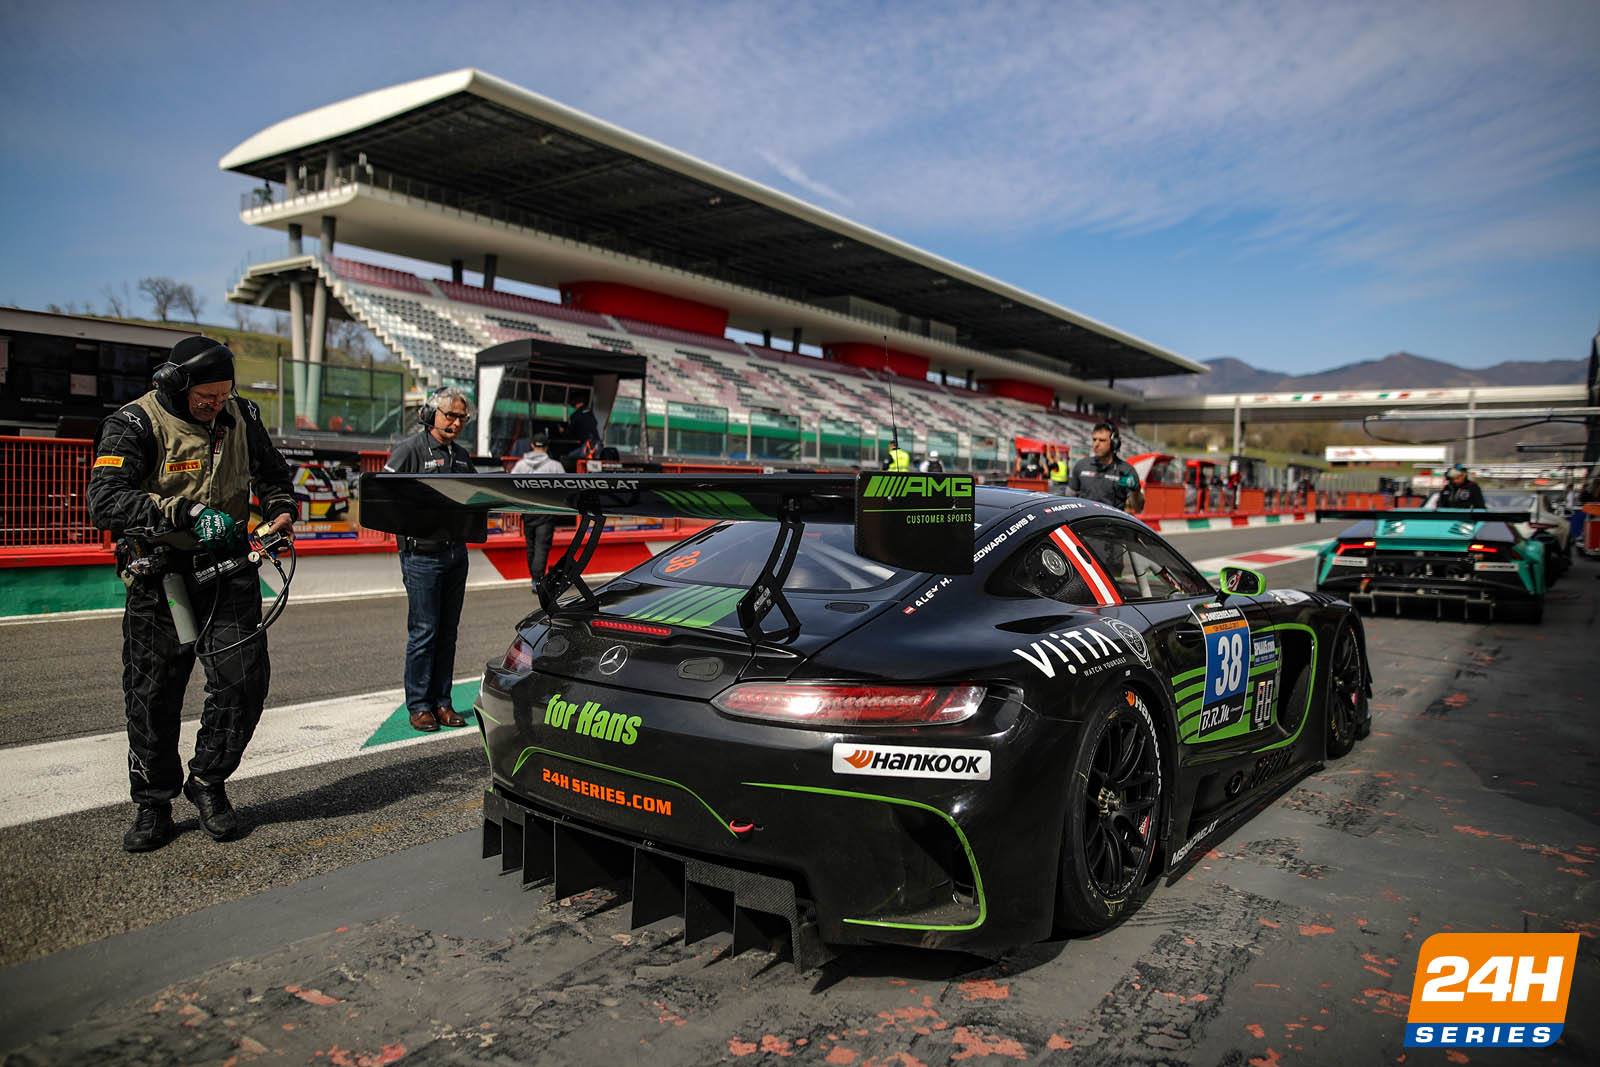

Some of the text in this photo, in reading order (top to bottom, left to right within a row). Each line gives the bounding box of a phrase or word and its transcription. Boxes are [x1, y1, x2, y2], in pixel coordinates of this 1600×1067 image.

[513, 479, 640, 490] MSRACING.AT
[901, 476, 973, 497] AMG
[1051, 502, 1078, 512] MARTIN
[906, 513, 972, 525] CUSTOMER SPORTS
[973, 534, 1008, 563] EDWARD
[1007, 519, 1029, 537] LEWIS
[940, 577, 953, 588] H.
[1083, 656, 1128, 678] WATCH YOURSELF
[1215, 633, 1243, 697] 38
[543, 693, 643, 746] for Hans
[542, 767, 672, 816] 24H SERIES.COM
